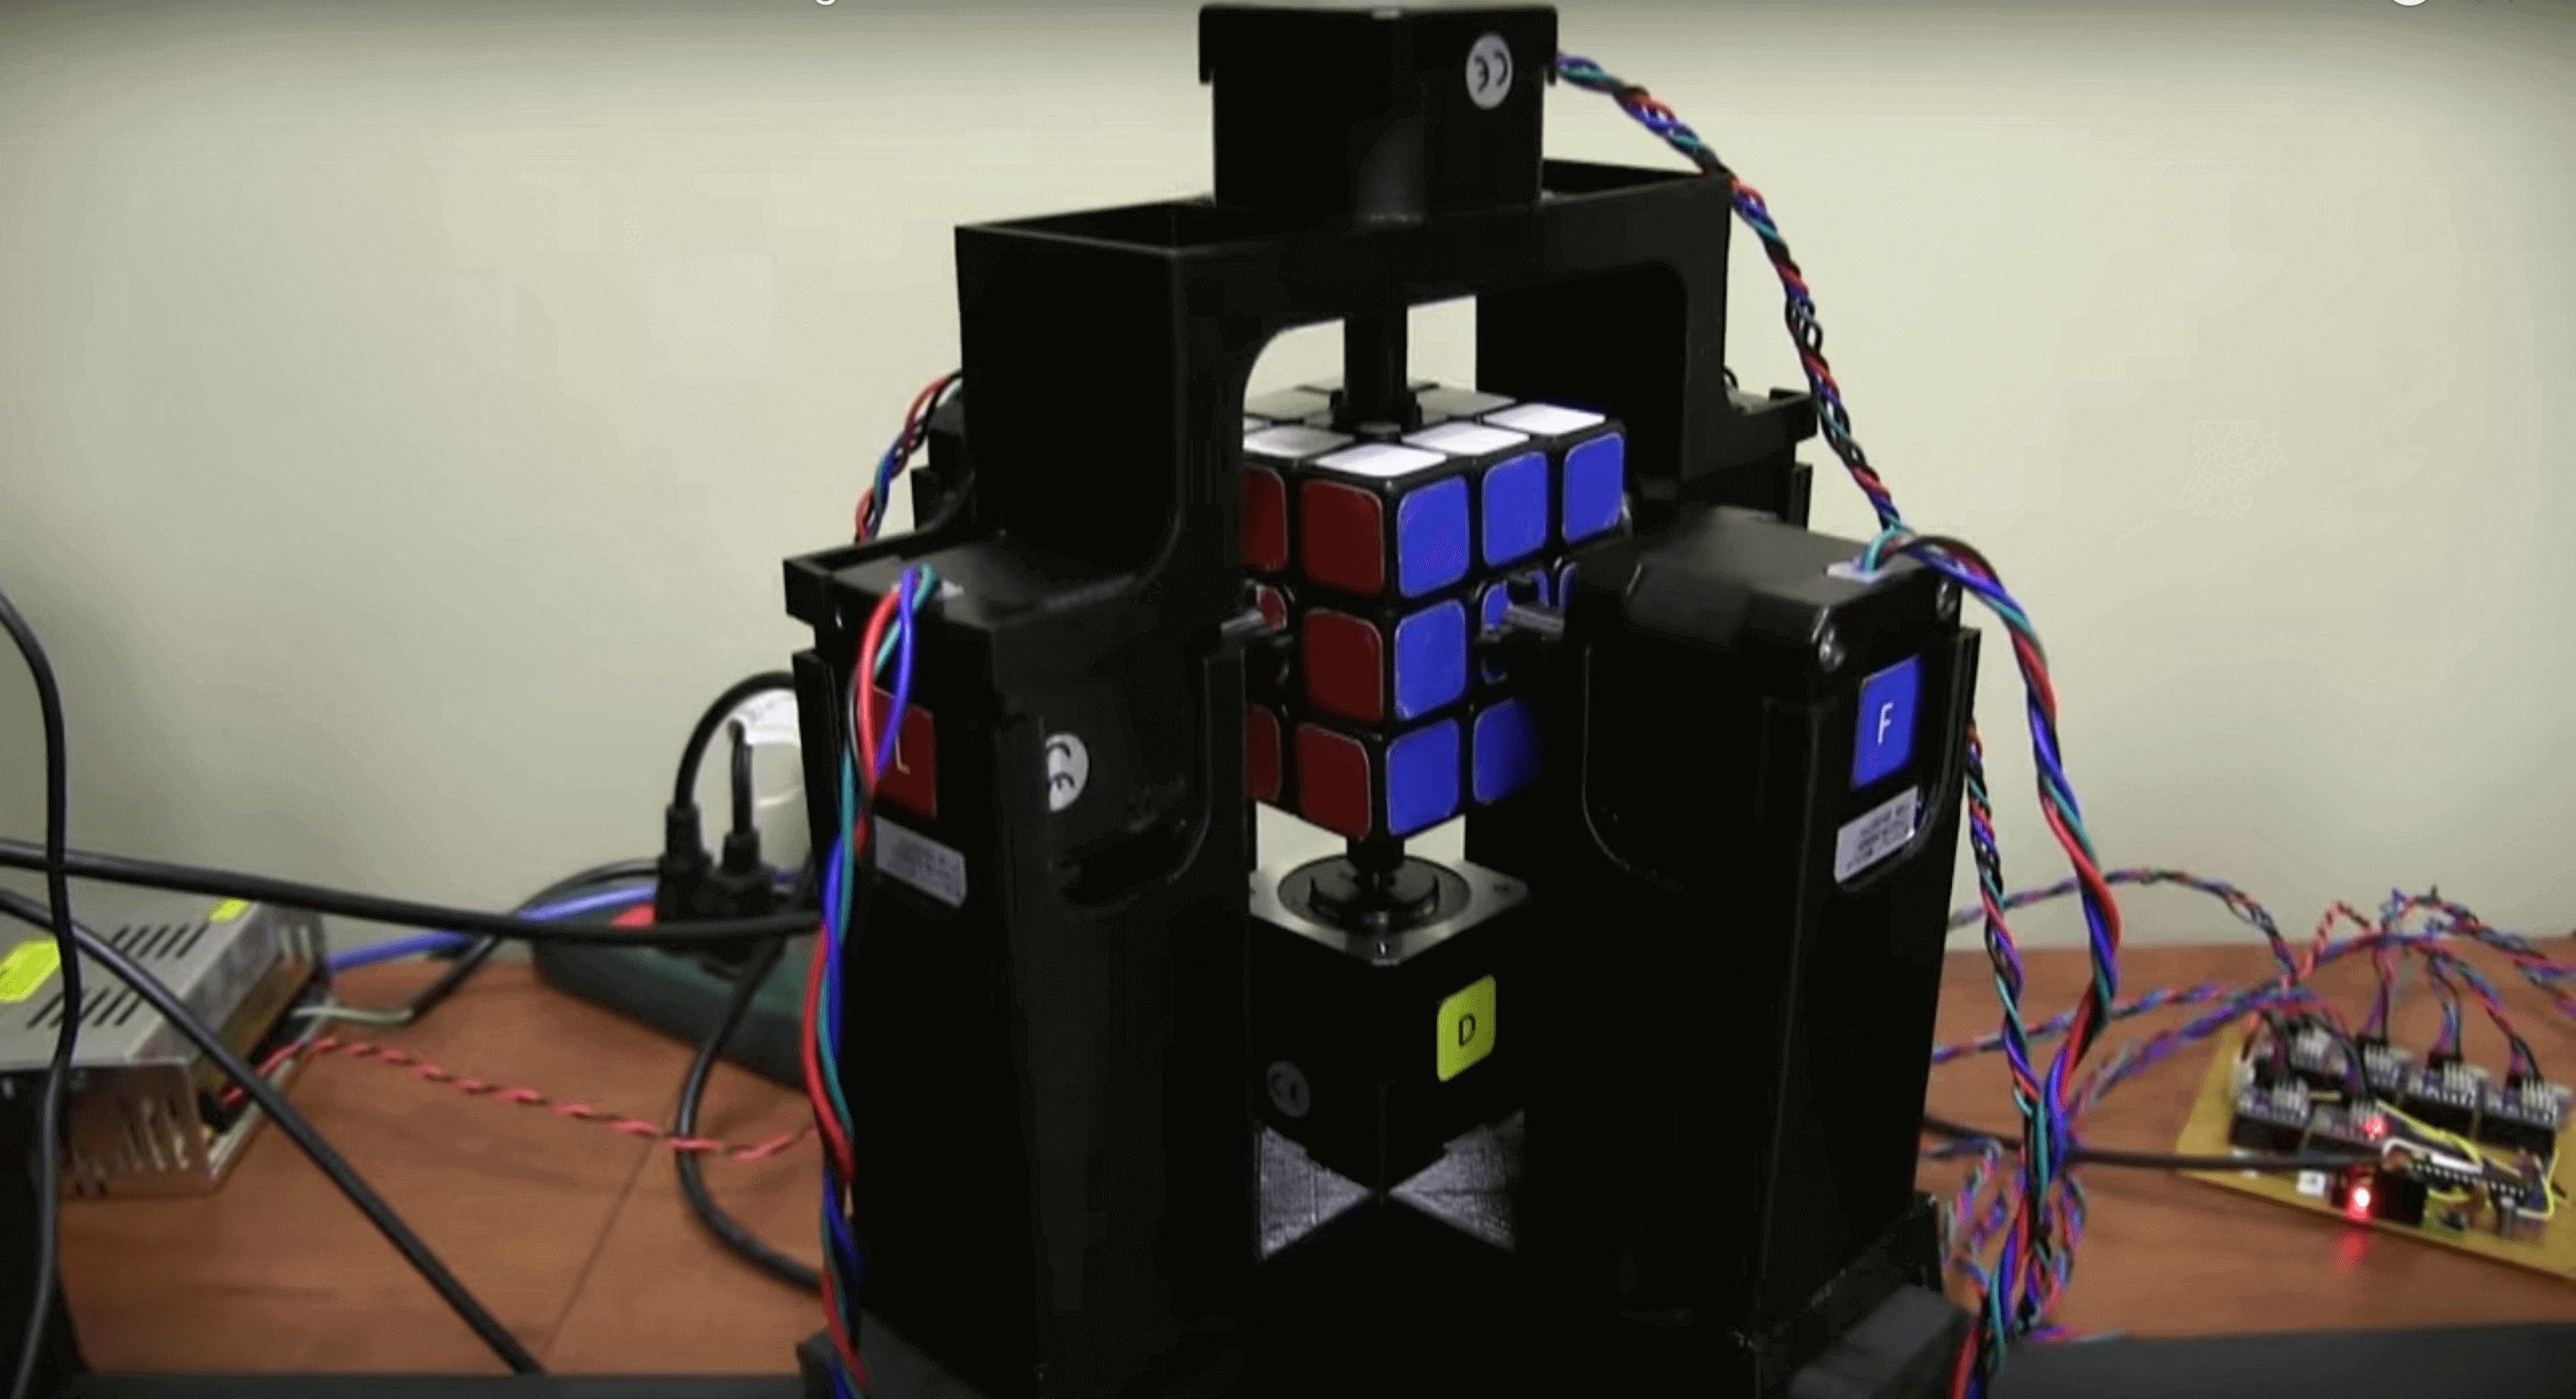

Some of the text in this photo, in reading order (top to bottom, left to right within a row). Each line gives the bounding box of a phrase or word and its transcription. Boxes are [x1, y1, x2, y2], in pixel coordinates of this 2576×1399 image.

[1877, 701, 1894, 746] F
[894, 728, 911, 775] L
[1458, 1013, 1476, 1047] D
